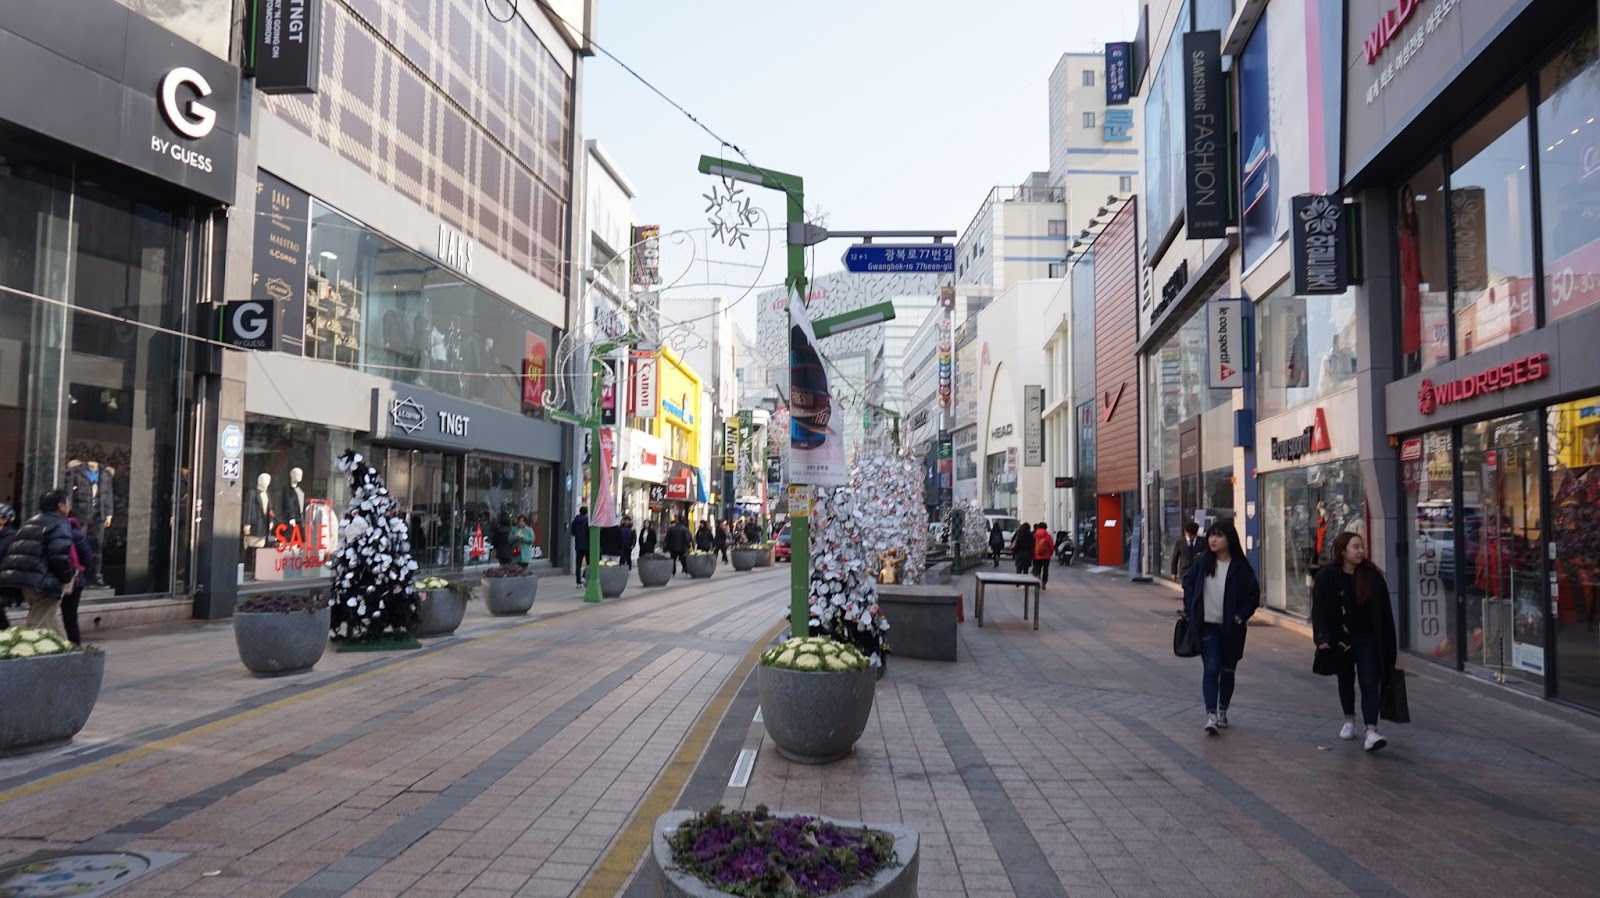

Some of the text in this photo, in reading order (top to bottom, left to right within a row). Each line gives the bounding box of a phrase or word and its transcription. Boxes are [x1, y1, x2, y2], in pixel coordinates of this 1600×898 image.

[158, 66, 217, 139] G
[1193, 50, 1216, 206] SAMSUNG FASHION
[151, 135, 213, 173] BY GUESS
[438, 223, 474, 275] DAKS
[867, 262, 953, 272] Gwangbok-ro 77beon-gil
[232, 302, 268, 340] G
[1218, 334, 1231, 364] sportif
[641, 362, 652, 407] Canon
[1433, 354, 1548, 406] WILDROSES
[438, 410, 470, 437] TNGT
[991, 423, 1013, 439] HEAD
[726, 425, 738, 464] Nikon
[668, 483, 686, 494] K2
[275, 523, 328, 553] SALE
[275, 557, 287, 571] UP
[290, 556, 302, 570] TO
